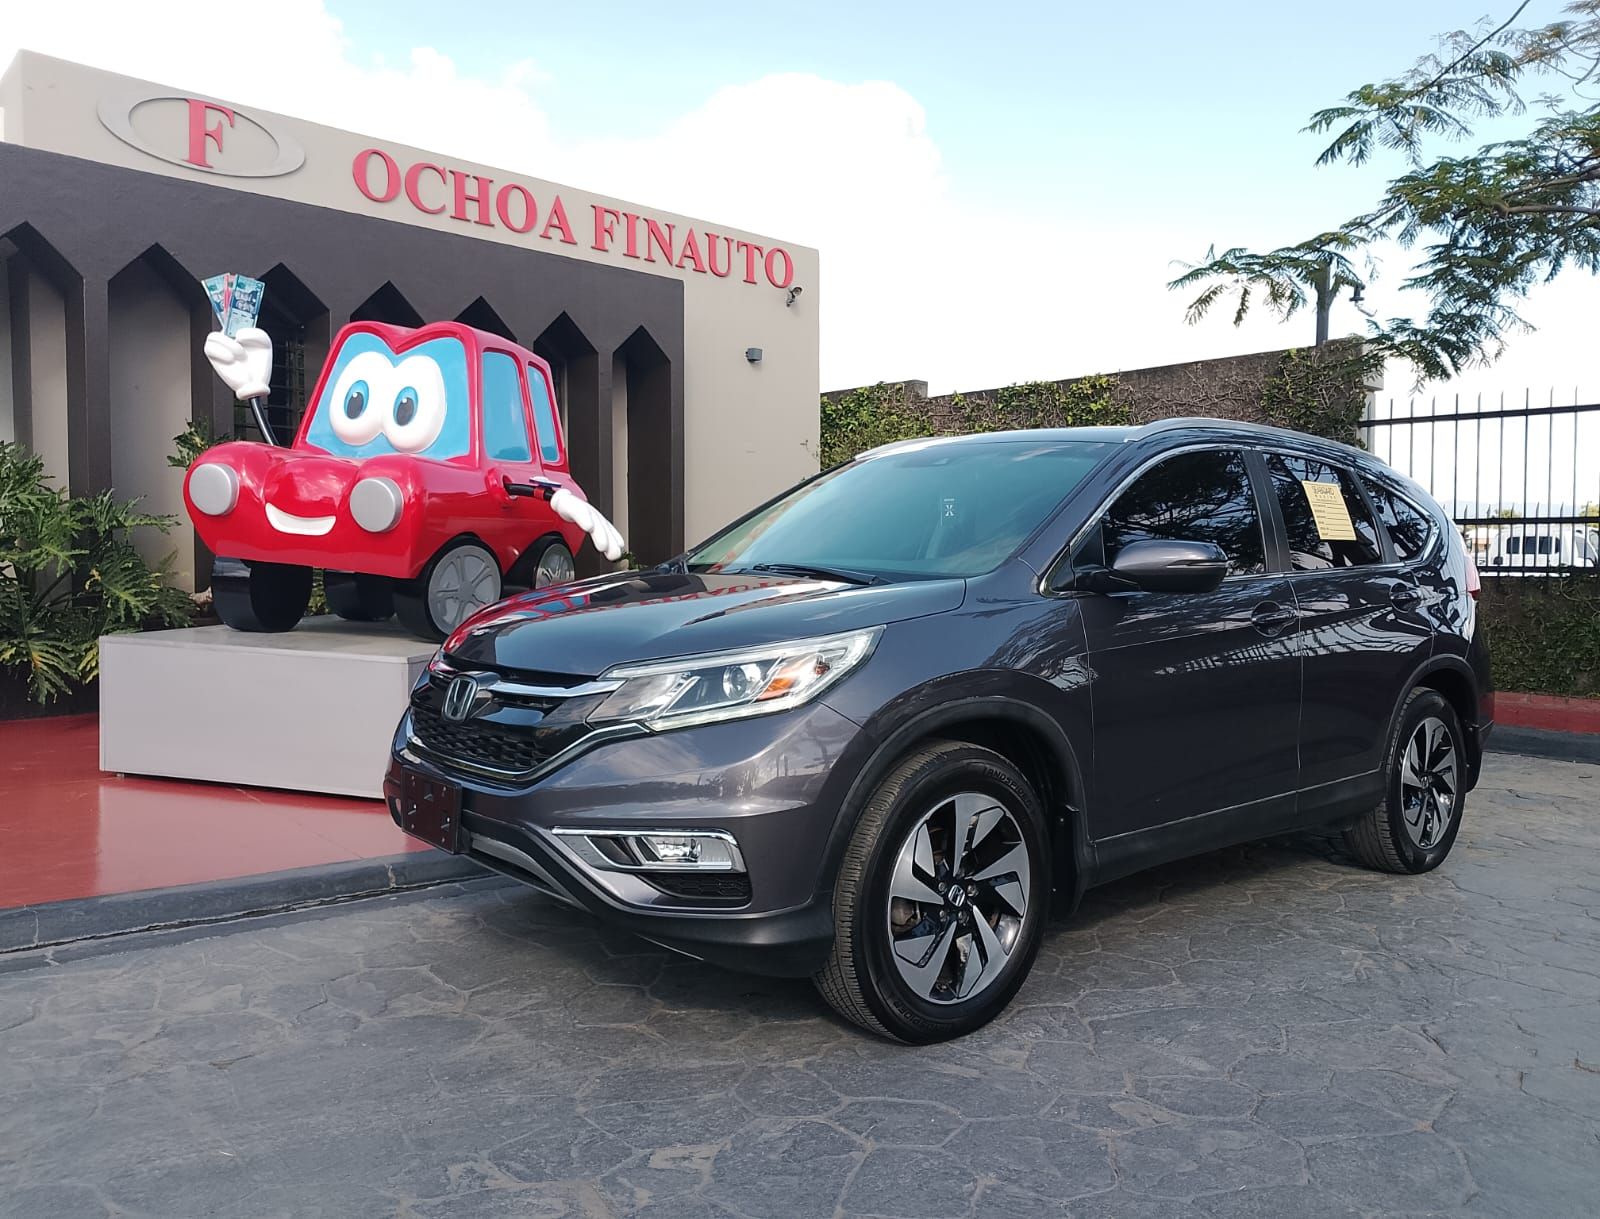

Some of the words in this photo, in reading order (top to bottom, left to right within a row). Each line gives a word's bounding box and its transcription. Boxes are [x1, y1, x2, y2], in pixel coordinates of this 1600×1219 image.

[184, 98, 235, 168] F
[352, 148, 577, 245] OCHOA
[590, 204, 794, 289] FINAUTO
